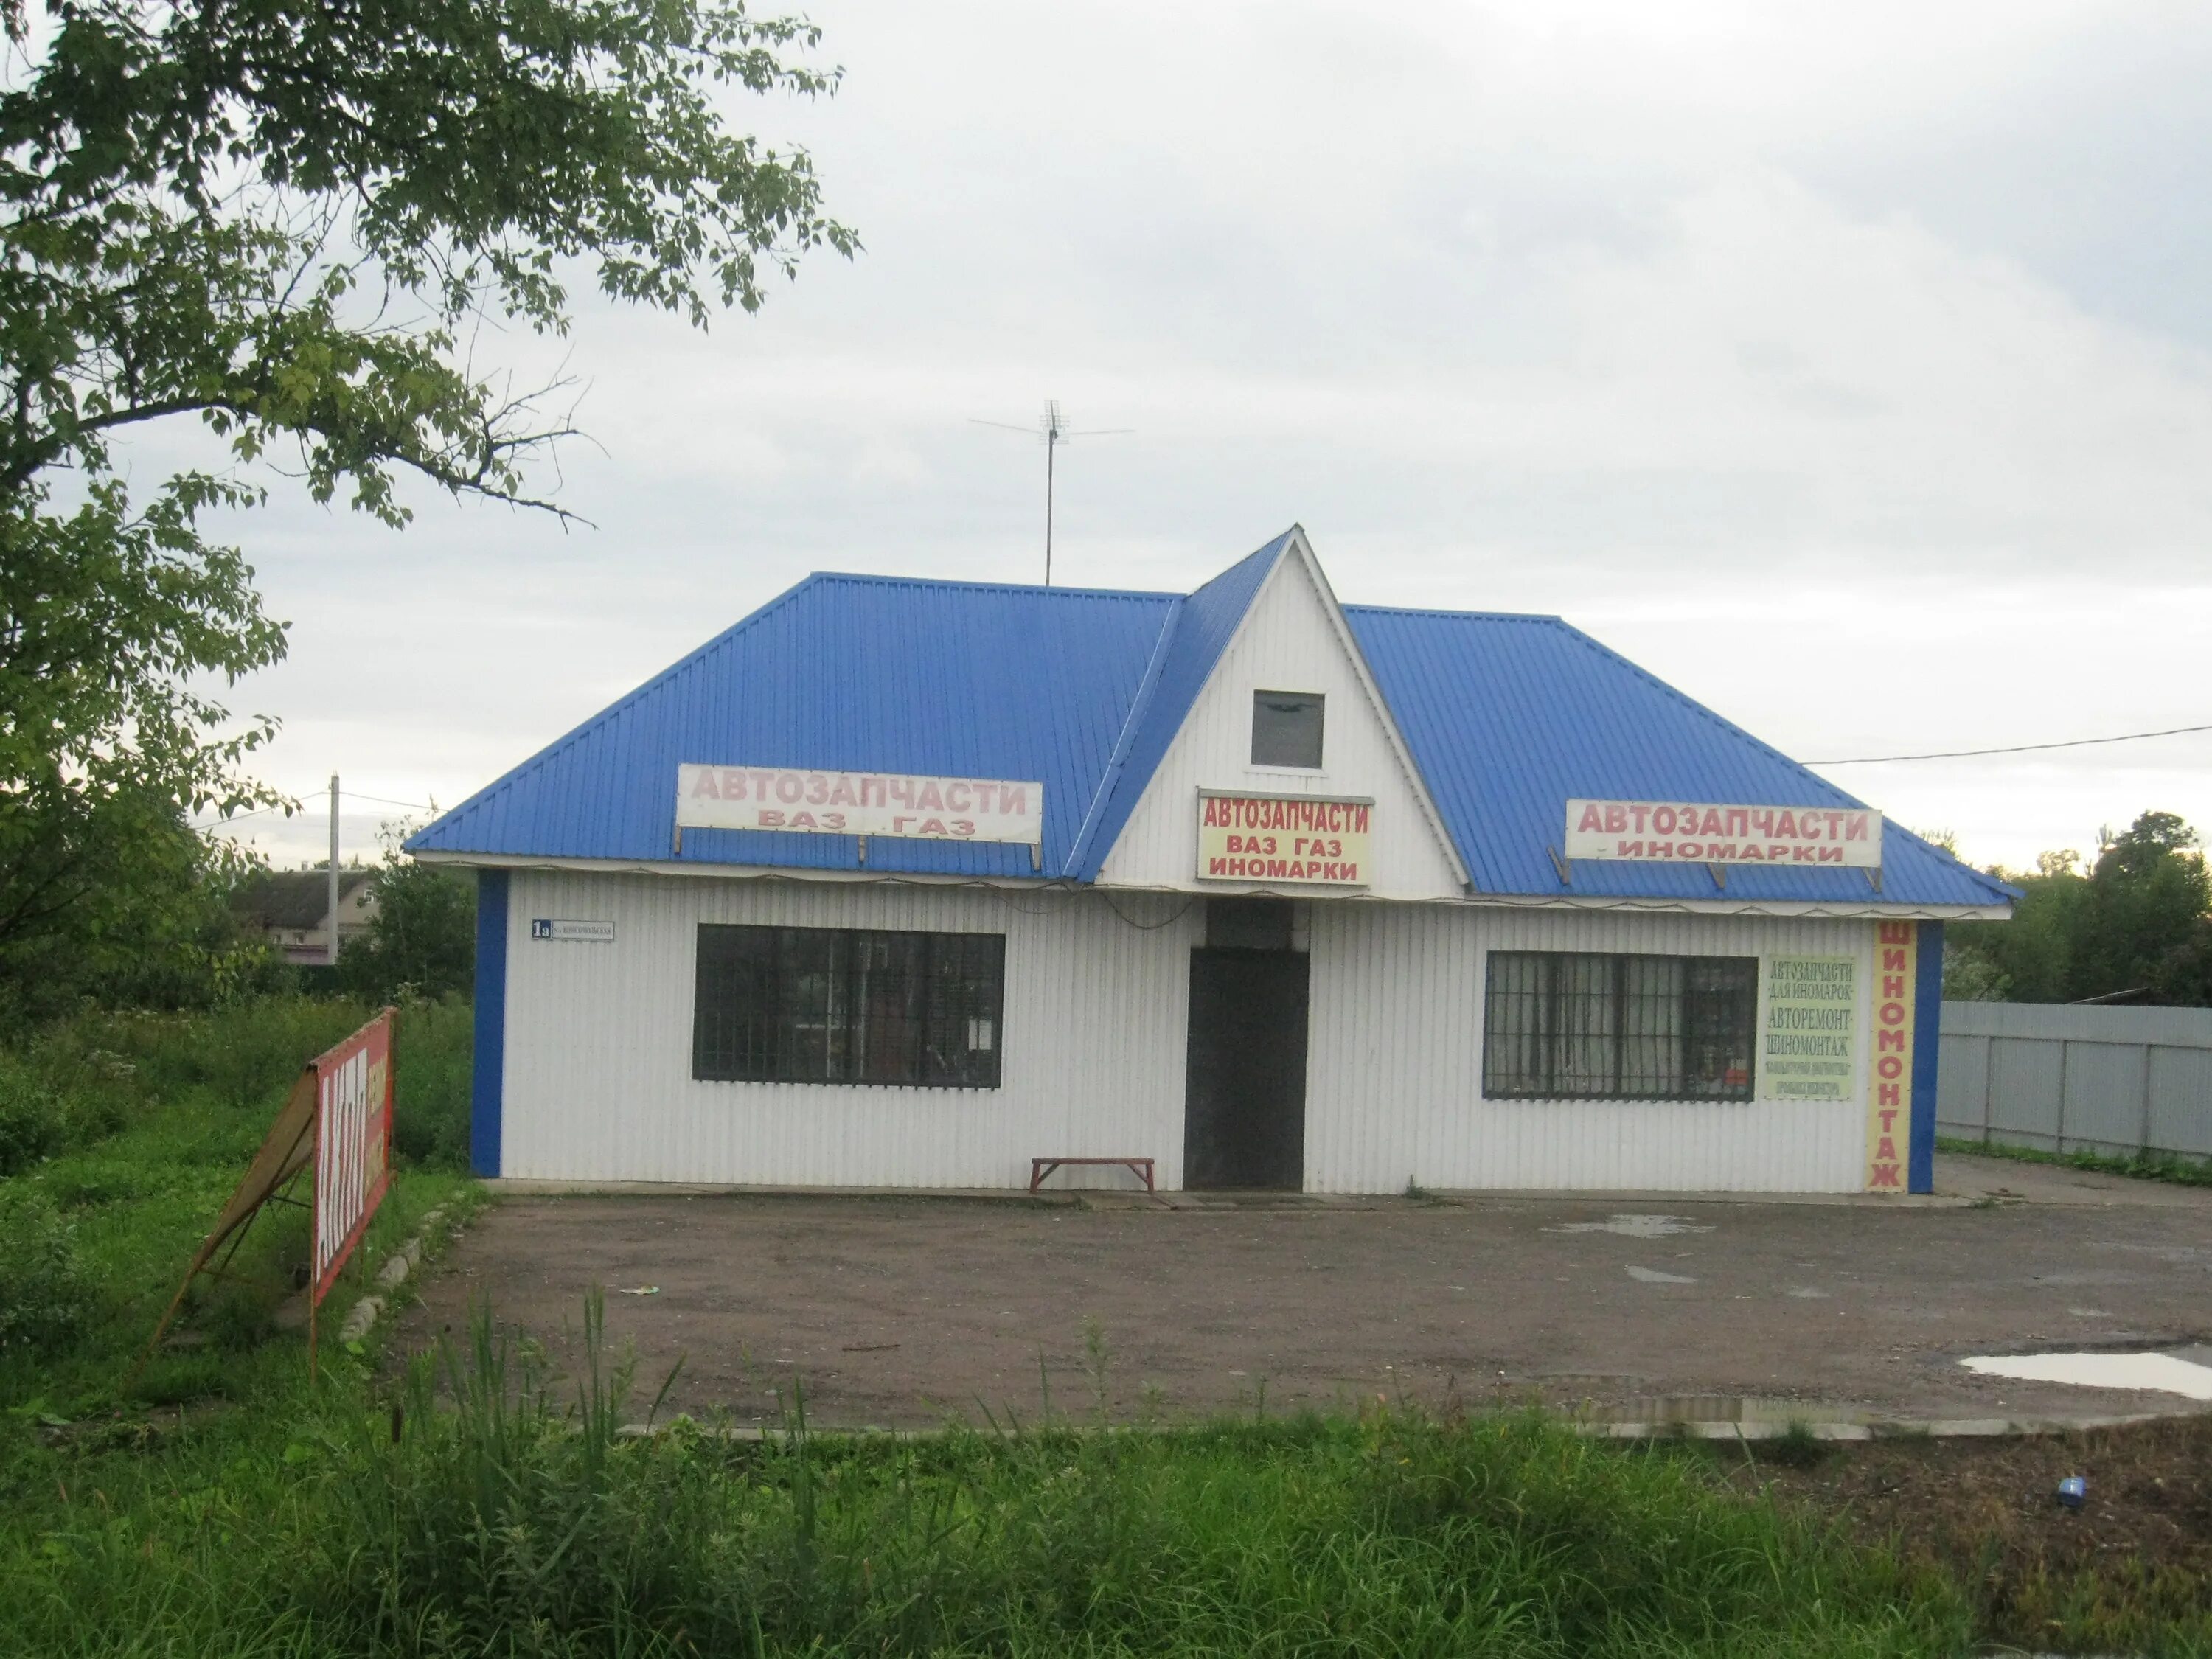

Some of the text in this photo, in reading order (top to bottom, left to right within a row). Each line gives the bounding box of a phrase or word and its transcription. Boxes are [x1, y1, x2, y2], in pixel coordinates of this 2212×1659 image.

[691, 769, 1026, 815] АВТОЗАПЧАСТИ
[757, 810, 976, 835] ВАЗ ГАЗ
[1203, 797, 1369, 833] АВТОЗАПЧАСТИ
[1577, 804, 1869, 841] АВТОЗАПЧАСТИ
[1226, 835, 1343, 858] ВАЗ ГАЗ
[1617, 841, 1843, 862] ИНОМАРКИ
[1209, 857, 1357, 880] ИНОМАРКИ
[1770, 961, 1853, 982] АВТОЗАПЧАСТИ
[1768, 1006, 1851, 1030] АВТОРЕМОНТ
[1766, 1034, 1849, 1057] ШИНОМОНТАЖ
[1868, 921, 1910, 1186] ШИНОМОНТАЖ
